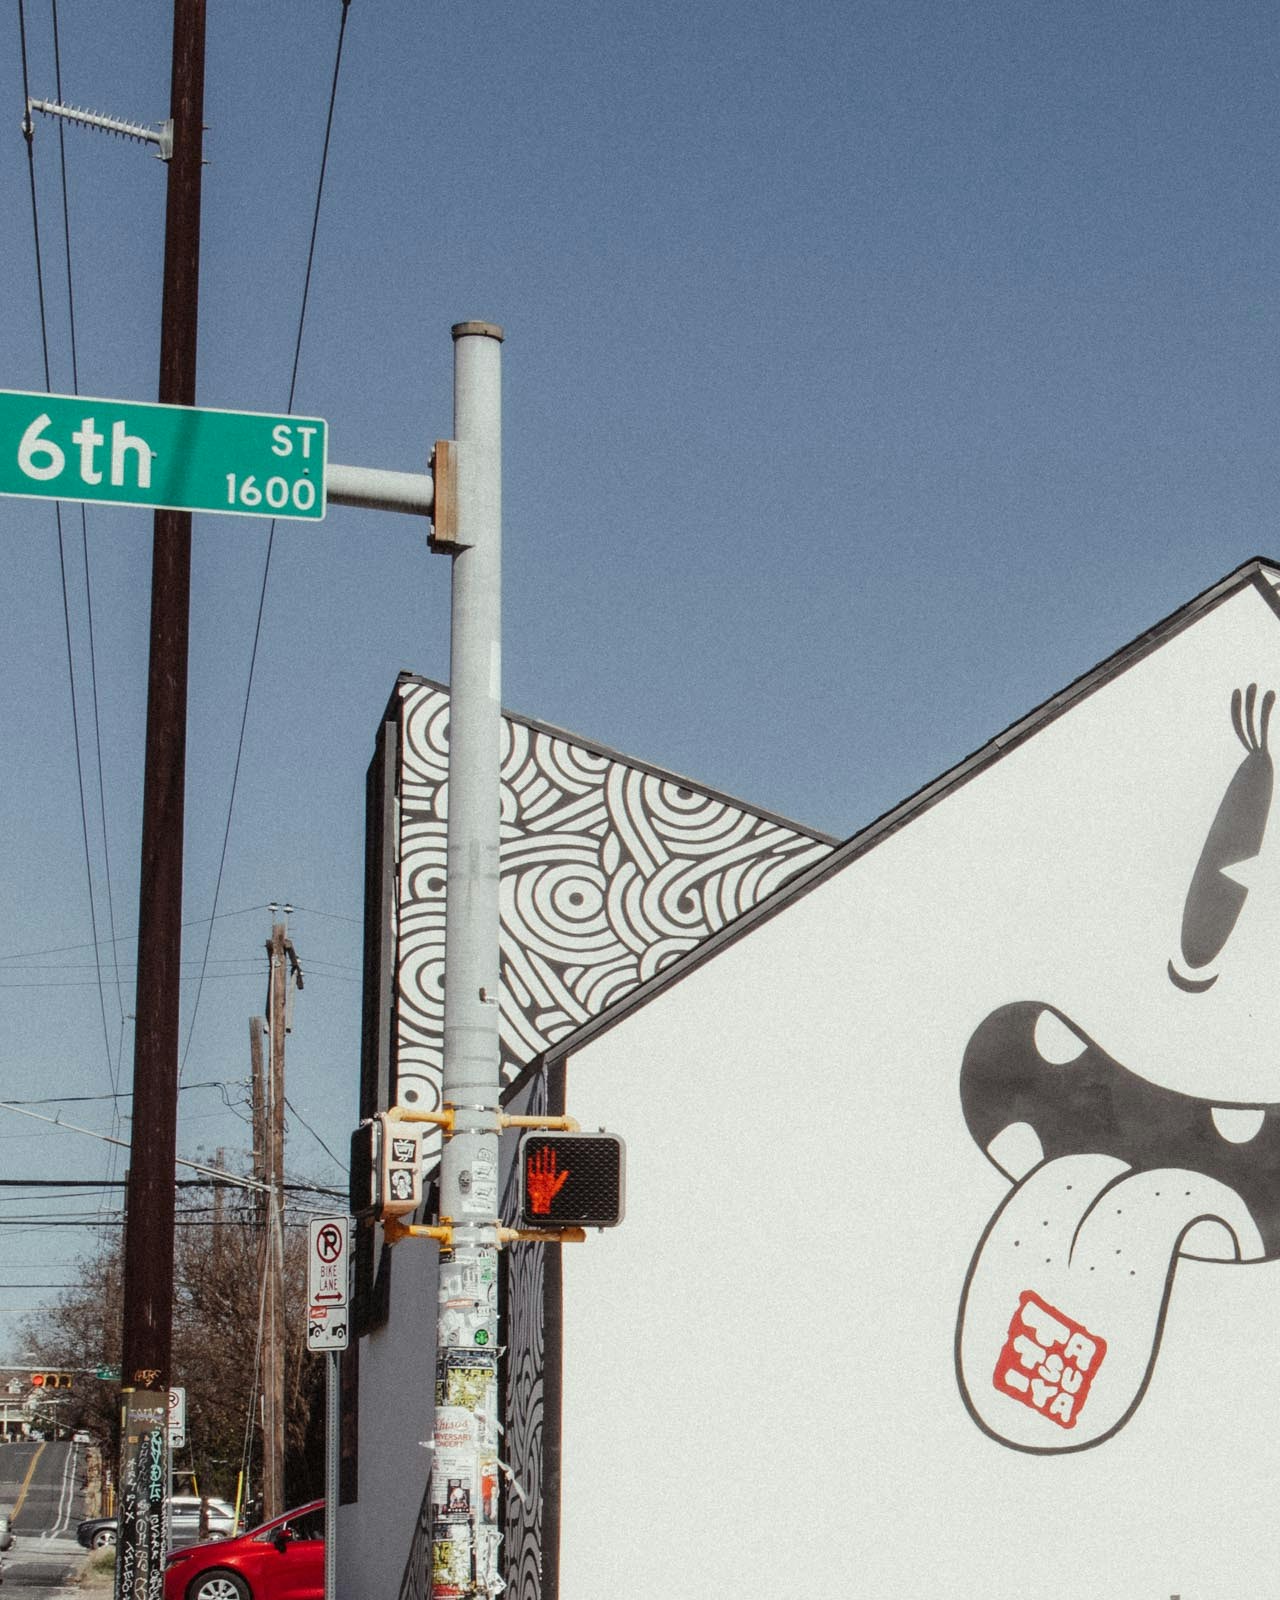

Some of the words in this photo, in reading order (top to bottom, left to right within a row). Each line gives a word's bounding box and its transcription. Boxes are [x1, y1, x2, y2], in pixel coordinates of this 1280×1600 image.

[18, 413, 151, 488] 6th
[271, 425, 318, 459] ST
[226, 473, 316, 510] 1600
[321, 1265, 337, 1277] BIKE
[320, 1279, 338, 1291] LANE
